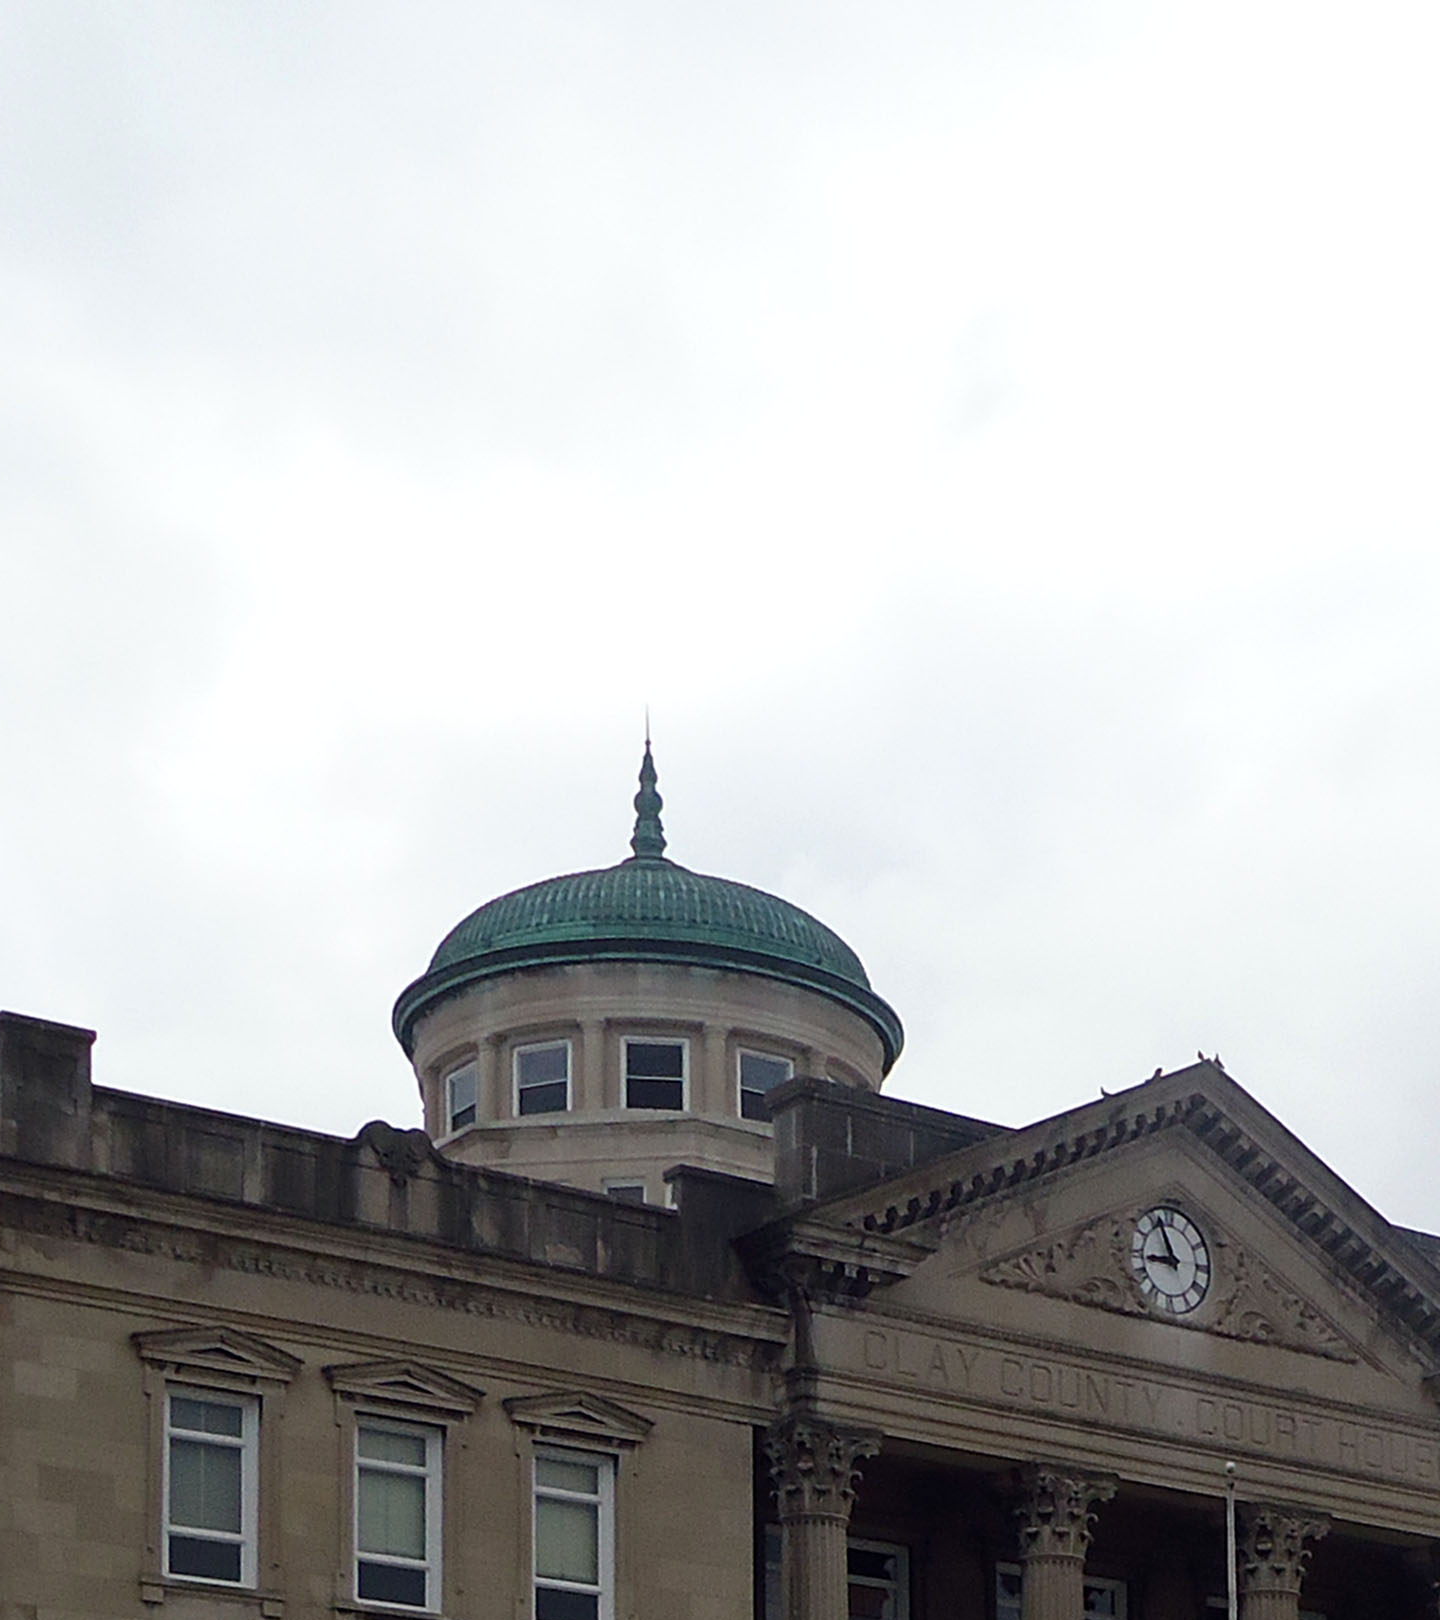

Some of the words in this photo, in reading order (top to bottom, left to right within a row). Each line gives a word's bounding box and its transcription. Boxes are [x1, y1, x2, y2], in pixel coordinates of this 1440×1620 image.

[863, 1330, 980, 1385] CLAY
[1001, 1357, 1161, 1423] COUNTY
[1196, 1398, 1323, 1452] COURT
